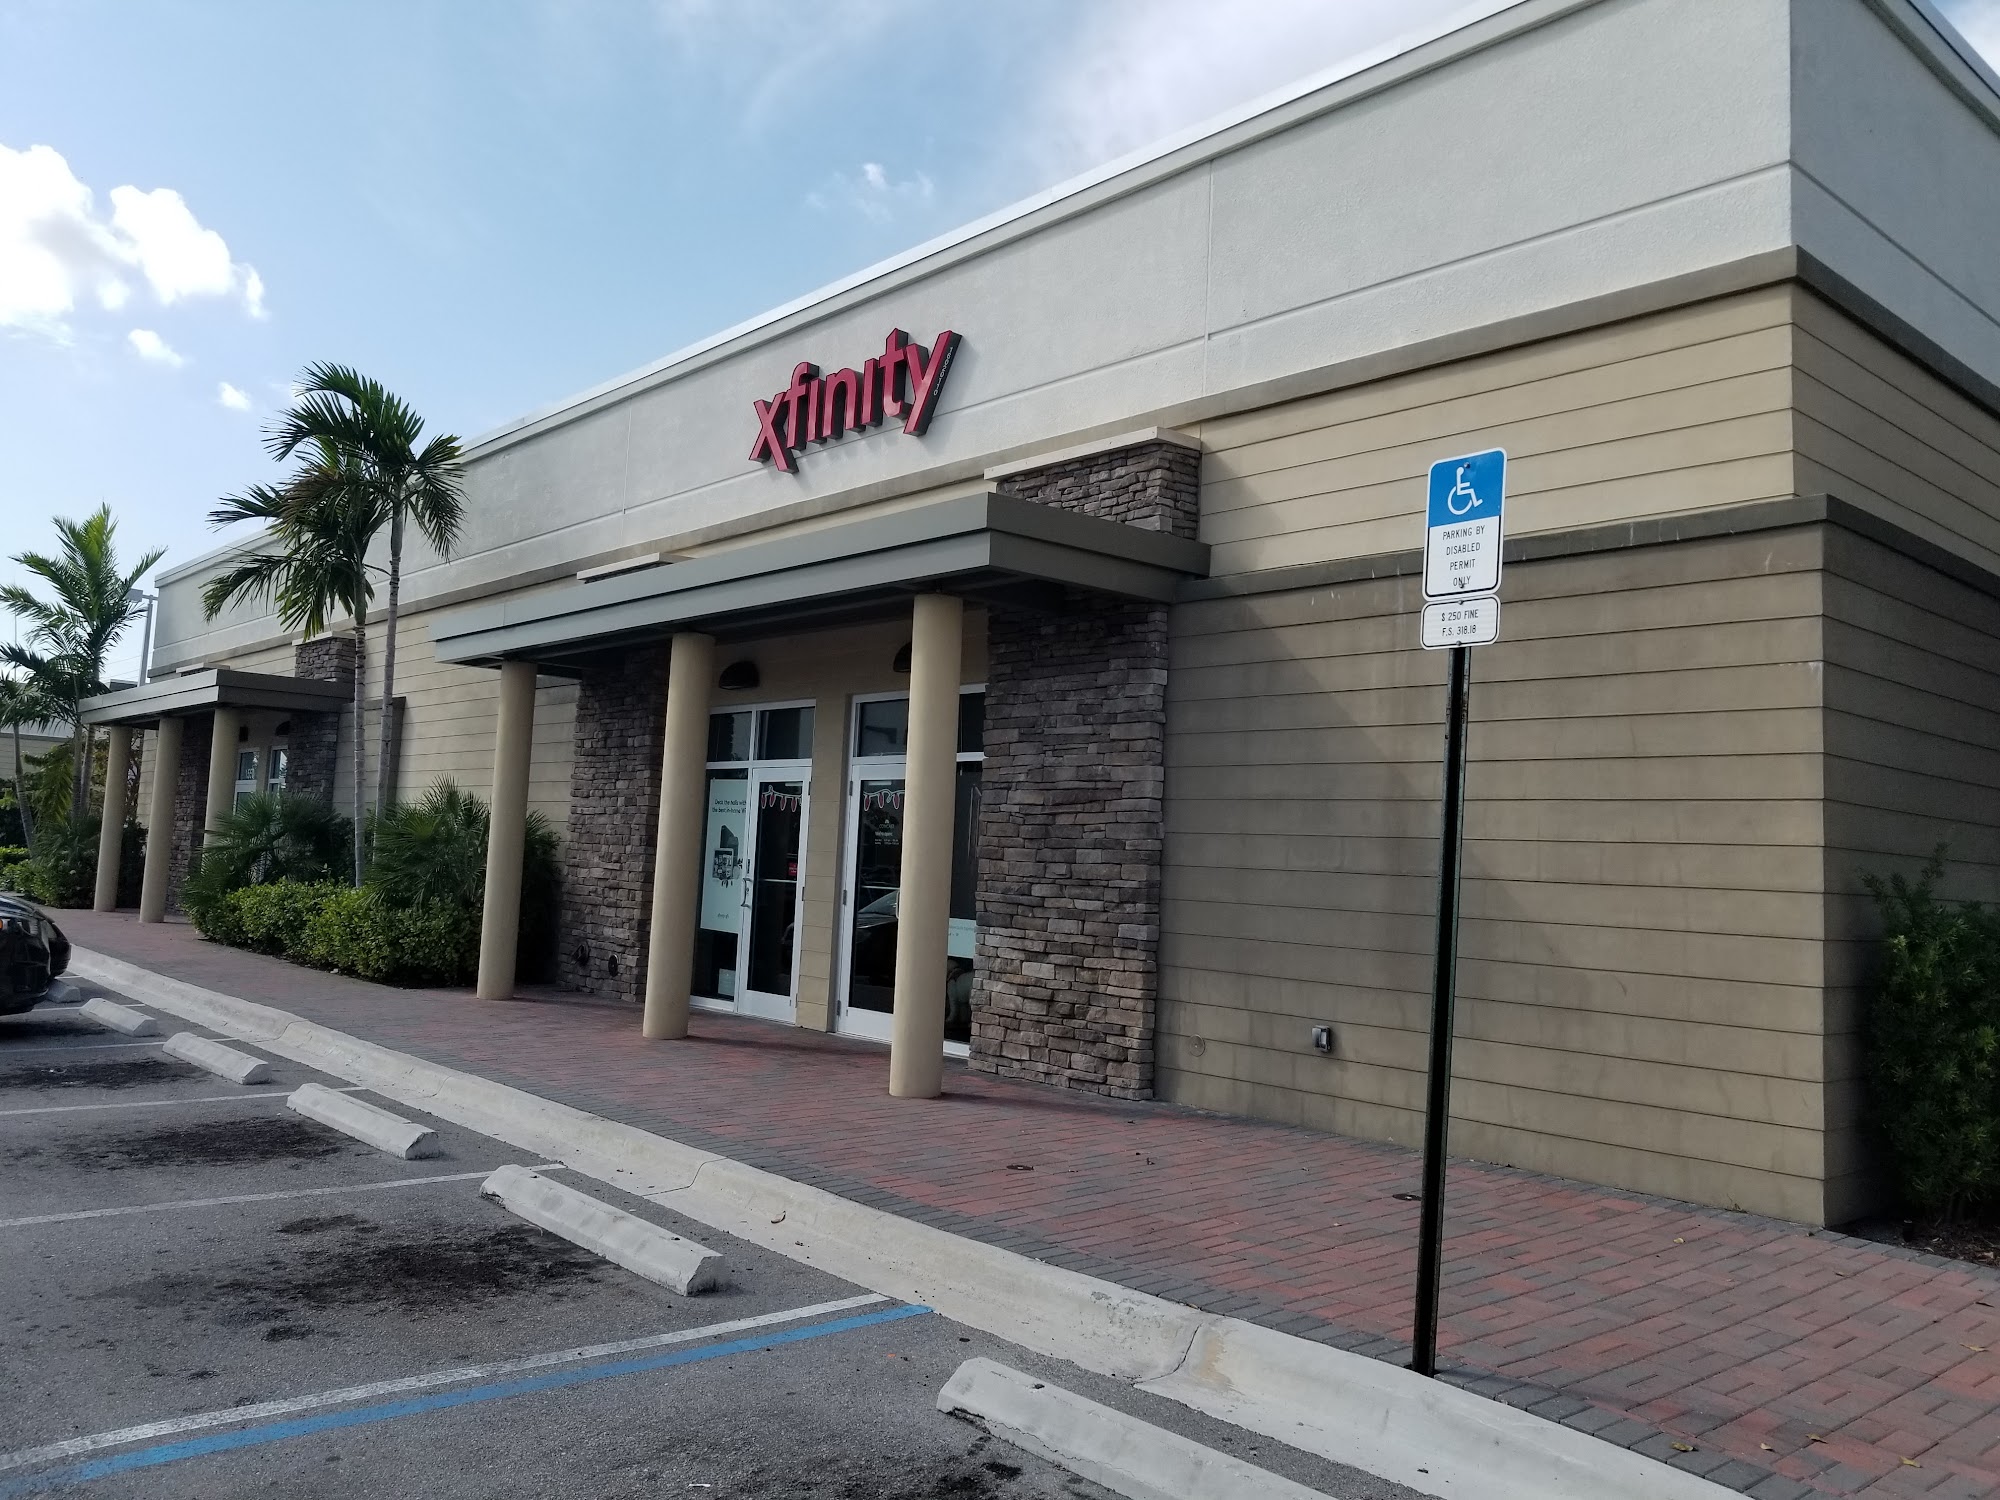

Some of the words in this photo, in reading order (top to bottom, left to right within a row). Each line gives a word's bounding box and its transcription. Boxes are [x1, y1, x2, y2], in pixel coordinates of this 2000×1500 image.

[748, 327, 963, 474] xfinity
[1442, 527, 1472, 541] PARKING
[1476, 524, 1486, 535] BY
[1446, 542, 1481, 556] DISABLED
[1449, 558, 1476, 571] PERMIT
[1452, 575, 1472, 587] ONLY
[1447, 610, 1462, 621] 250
[1463, 608, 1479, 620] FINE
[1441, 626, 1455, 637] F.S.
[1456, 624, 1477, 635] 318.18
